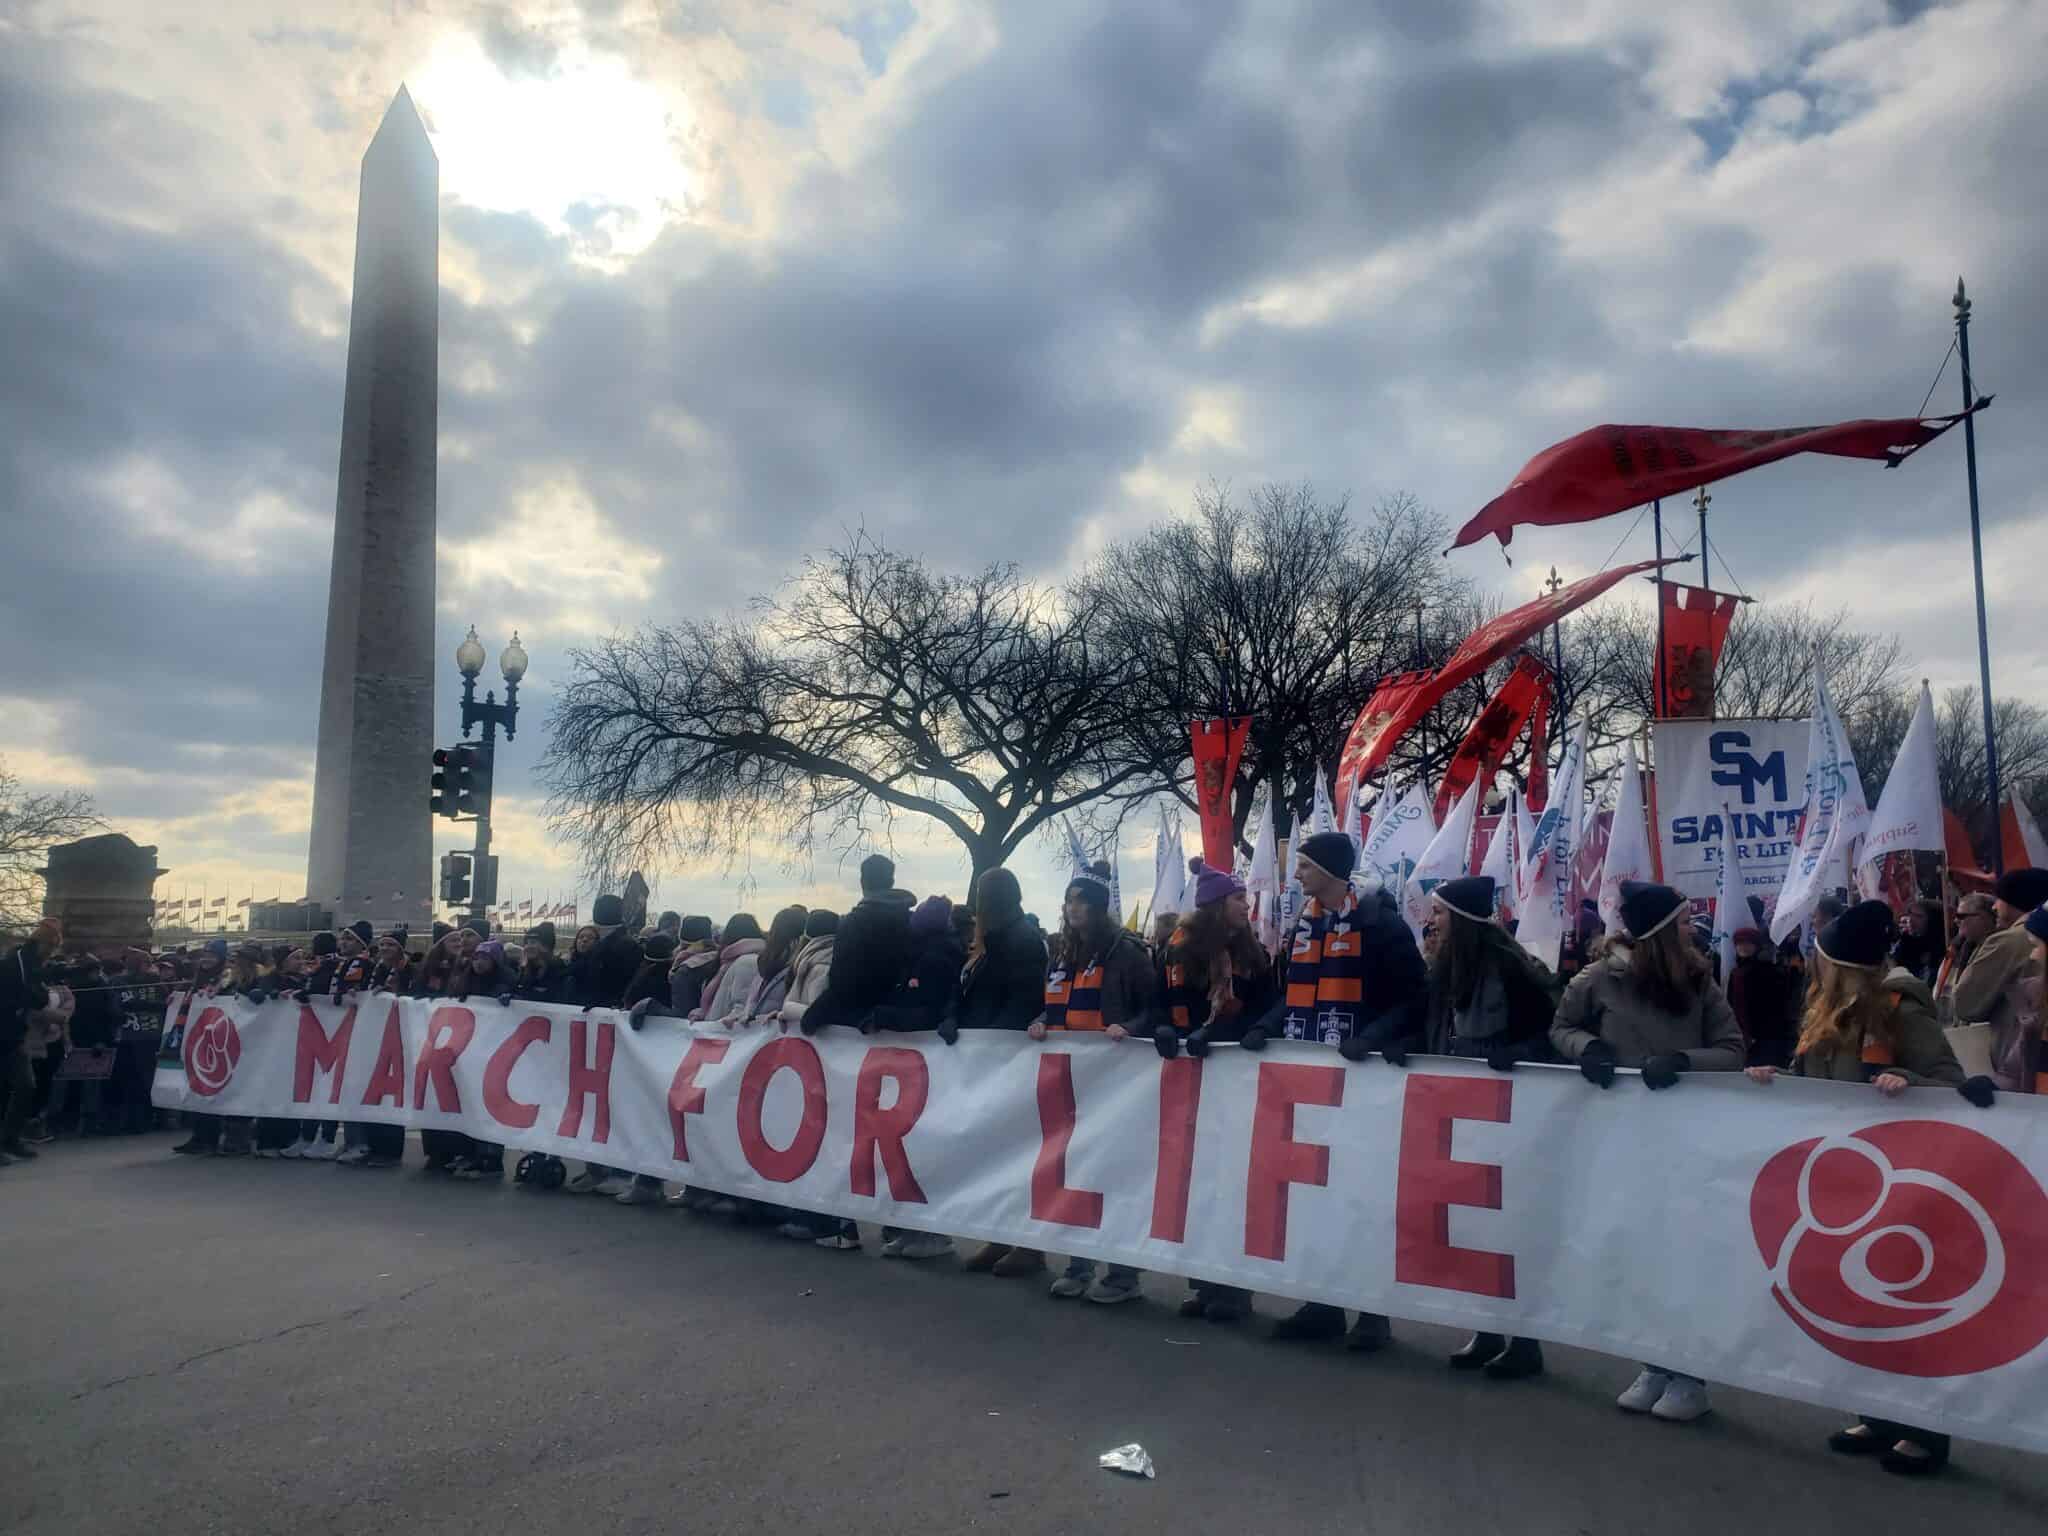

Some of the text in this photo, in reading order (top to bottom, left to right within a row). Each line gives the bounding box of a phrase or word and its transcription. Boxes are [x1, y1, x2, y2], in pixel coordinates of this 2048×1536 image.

[1709, 731, 1788, 804] SM
[1672, 808, 1803, 845] SAINT
[1704, 841, 1792, 862] FR LIF
[292, 1001, 1516, 1299] MARCH FOR LIFE
